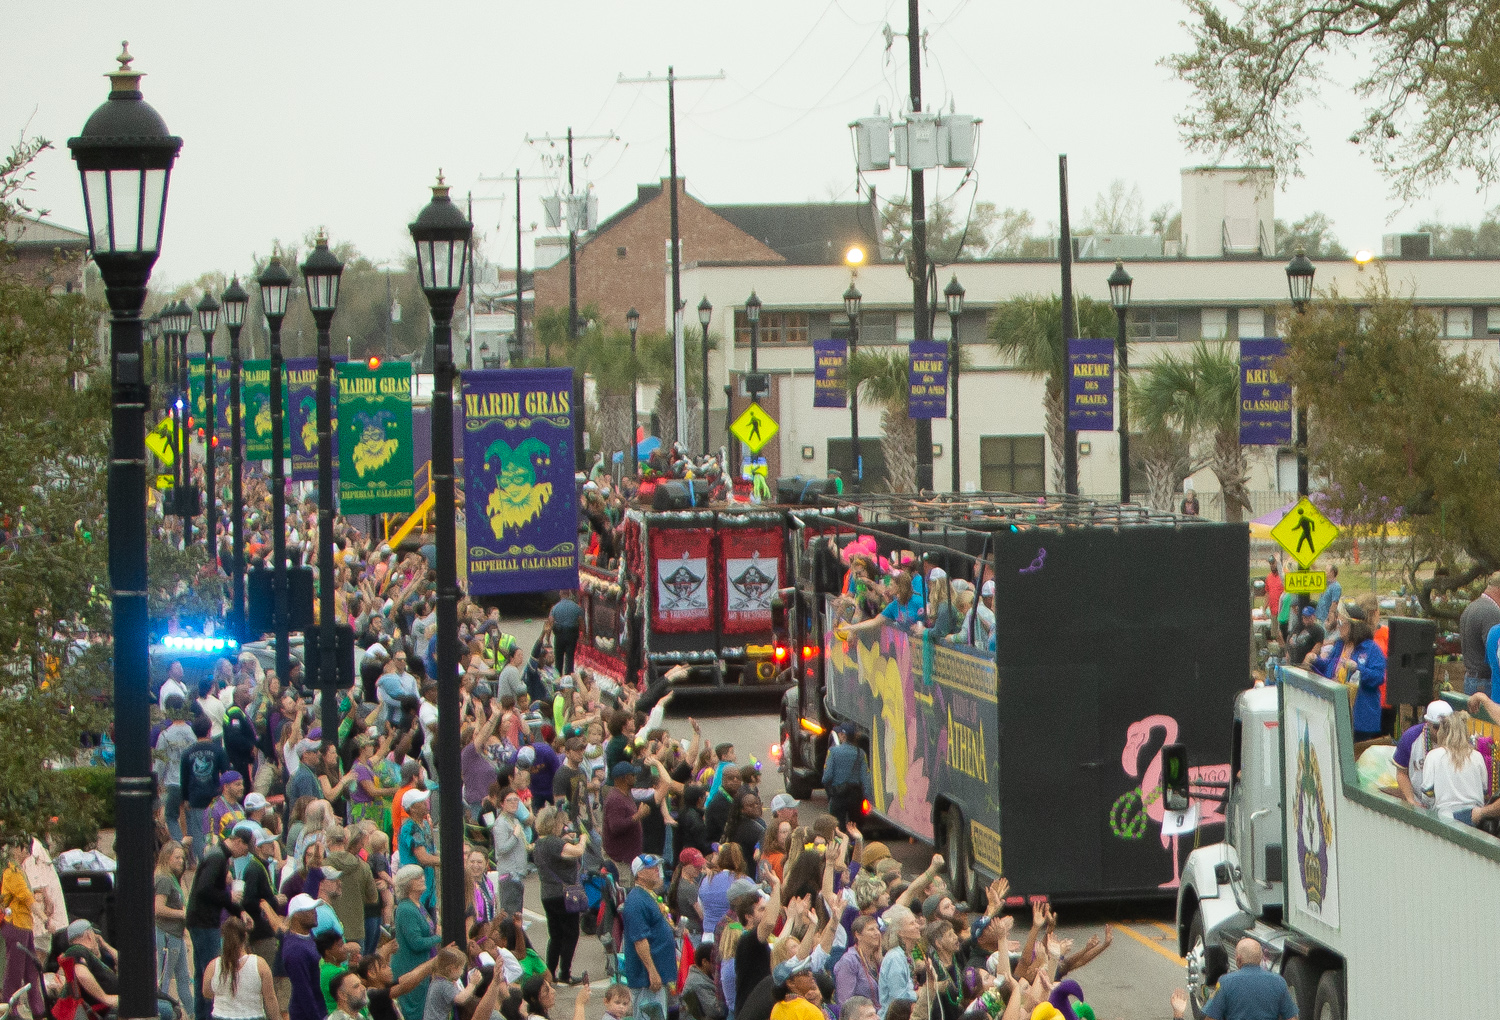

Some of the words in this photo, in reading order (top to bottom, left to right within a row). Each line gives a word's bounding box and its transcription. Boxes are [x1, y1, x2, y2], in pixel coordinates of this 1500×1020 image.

[913, 360, 943, 372] KREWE
[1073, 364, 1109, 376] KREWE
[1246, 369, 1279, 384] KREW
[339, 378, 376, 394] MARDI
[380, 376, 410, 393] GRAS
[465, 392, 520, 418] MARDI
[525, 391, 570, 416] GRAS
[1075, 394, 1108, 404] PIRATES
[1243, 400, 1289, 412] CLASSIQUE
[470, 558, 519, 573] IMPERIAL
[521, 555, 574, 570] CALCASIEU
[1288, 575, 1322, 587] AHEAD
[946, 702, 988, 783] ATHENA
[1175, 813, 1185, 828] 9
